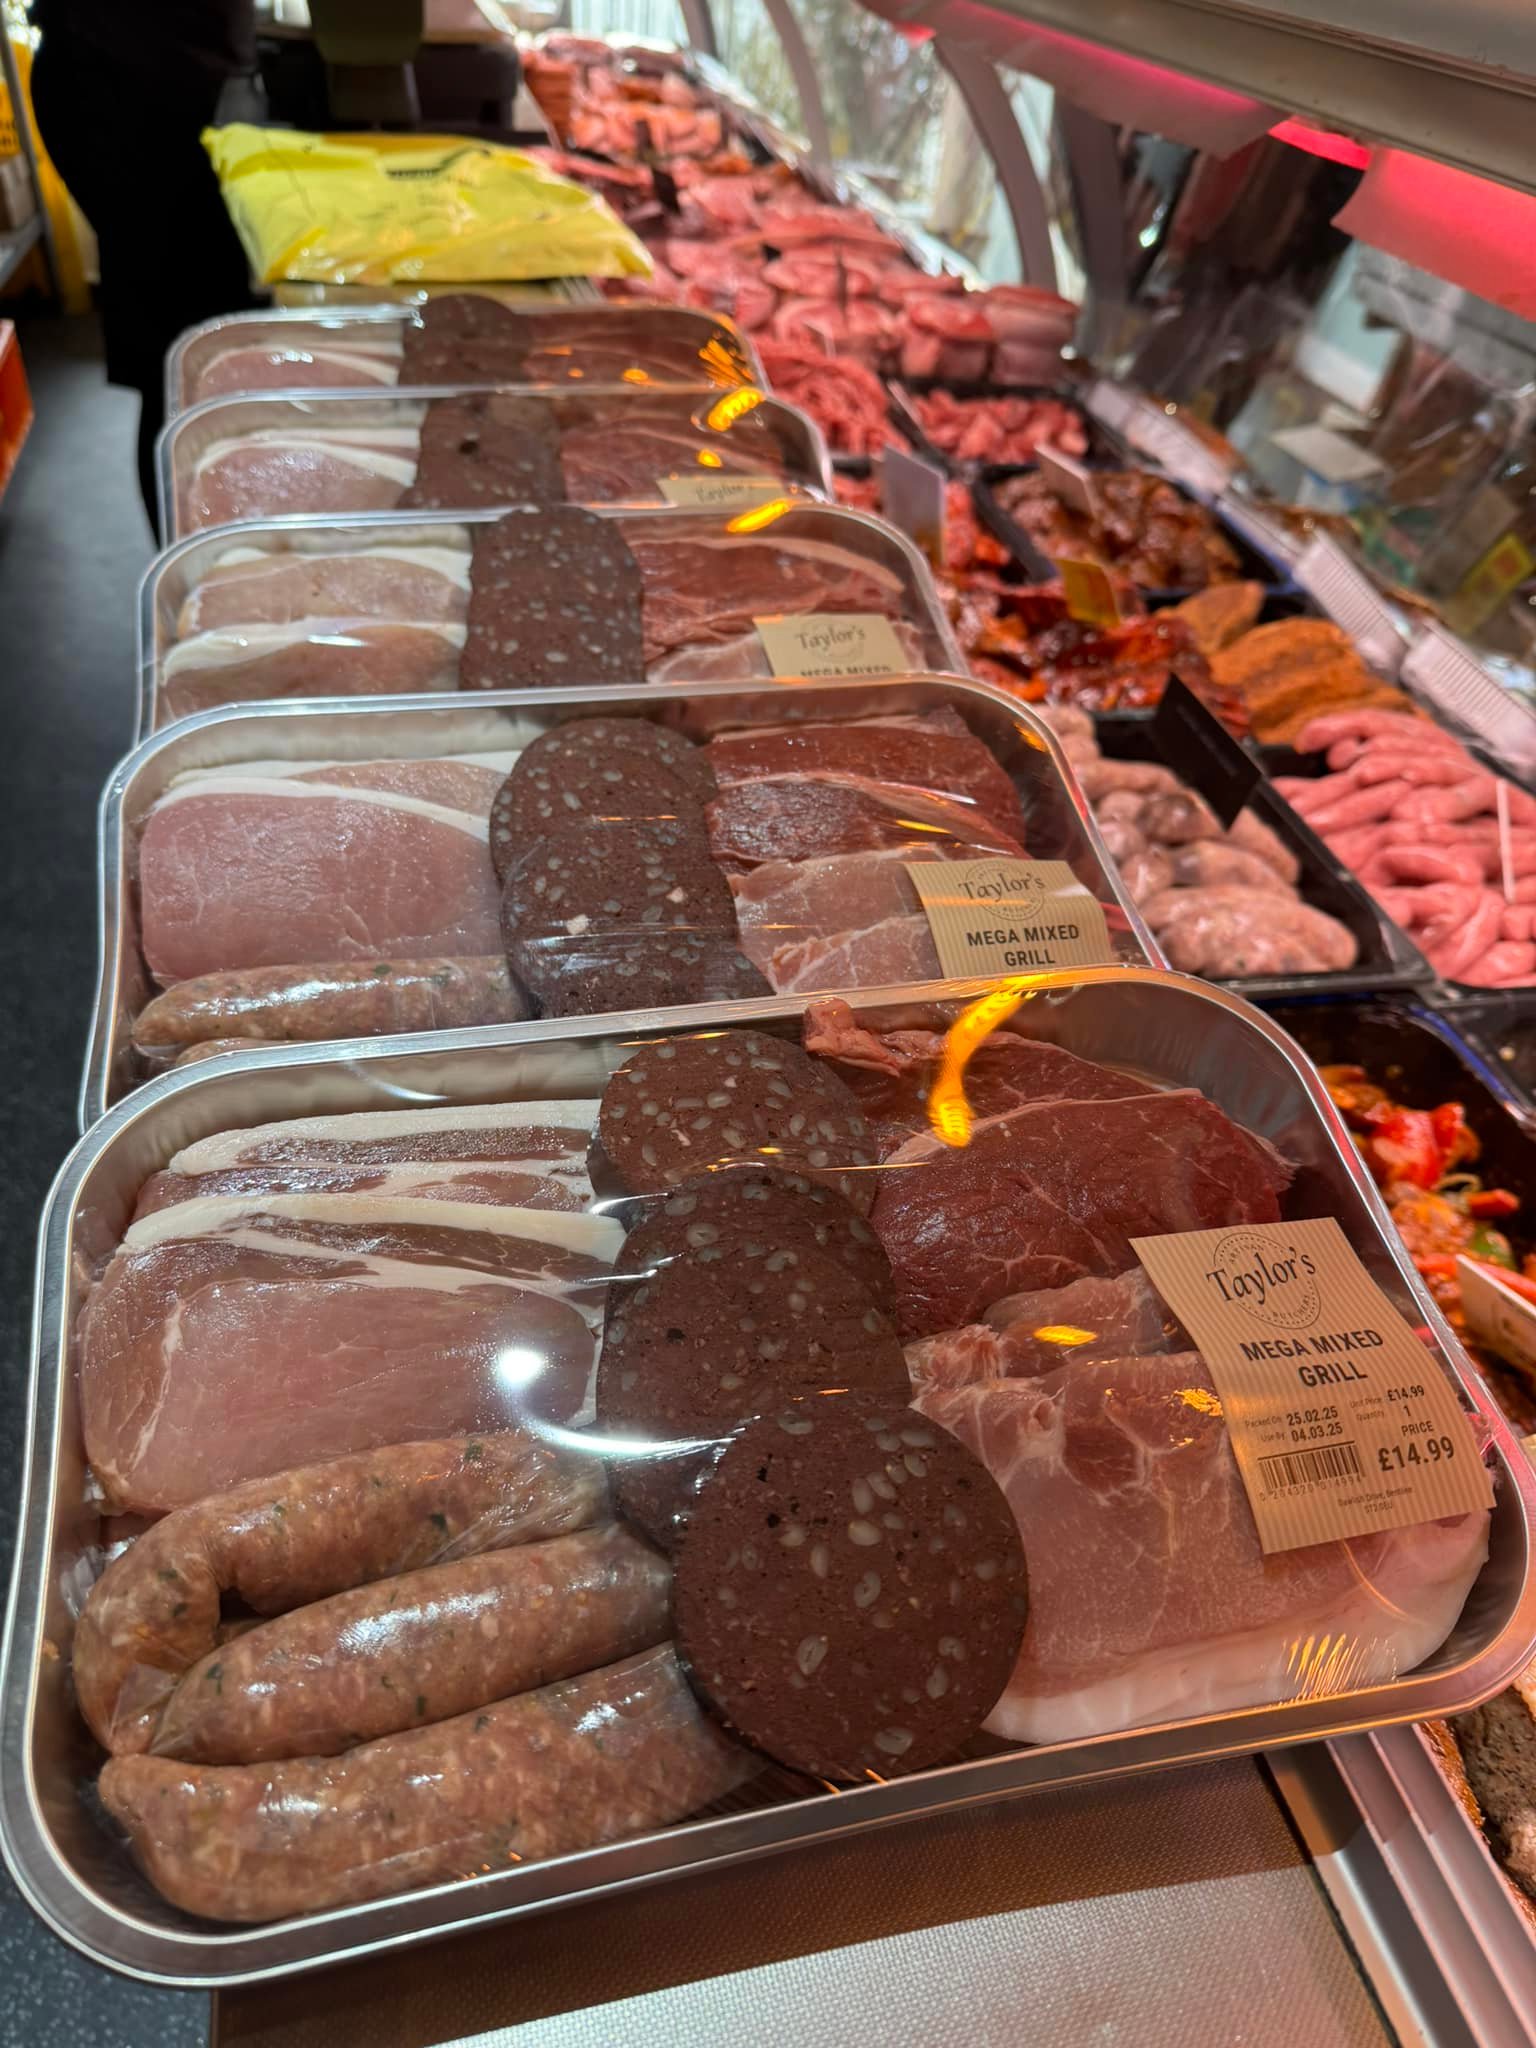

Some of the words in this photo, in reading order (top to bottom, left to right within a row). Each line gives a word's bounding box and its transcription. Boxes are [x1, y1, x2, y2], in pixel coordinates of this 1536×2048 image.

[795, 625, 867, 651] Taylor's
[958, 872, 1046, 902] Taylor's
[966, 928, 1020, 947] MEGA
[1023, 924, 1080, 943] MIXED
[1004, 948, 1056, 966] GRILL
[1206, 1246, 1316, 1305] Taylor's
[1239, 1337, 1312, 1362] MEGA
[1308, 1329, 1384, 1355] MIXED
[1298, 1360, 1369, 1388] GRILL
[1387, 1384, 1425, 1402] £14.99
[1286, 1405, 1338, 1427] 25.02.25
[1403, 1405, 1412, 1417] 1
[1291, 1421, 1343, 1442] 04.03.25
[1401, 1420, 1435, 1437] PRICE
[1378, 1436, 1455, 1472] £14.99
